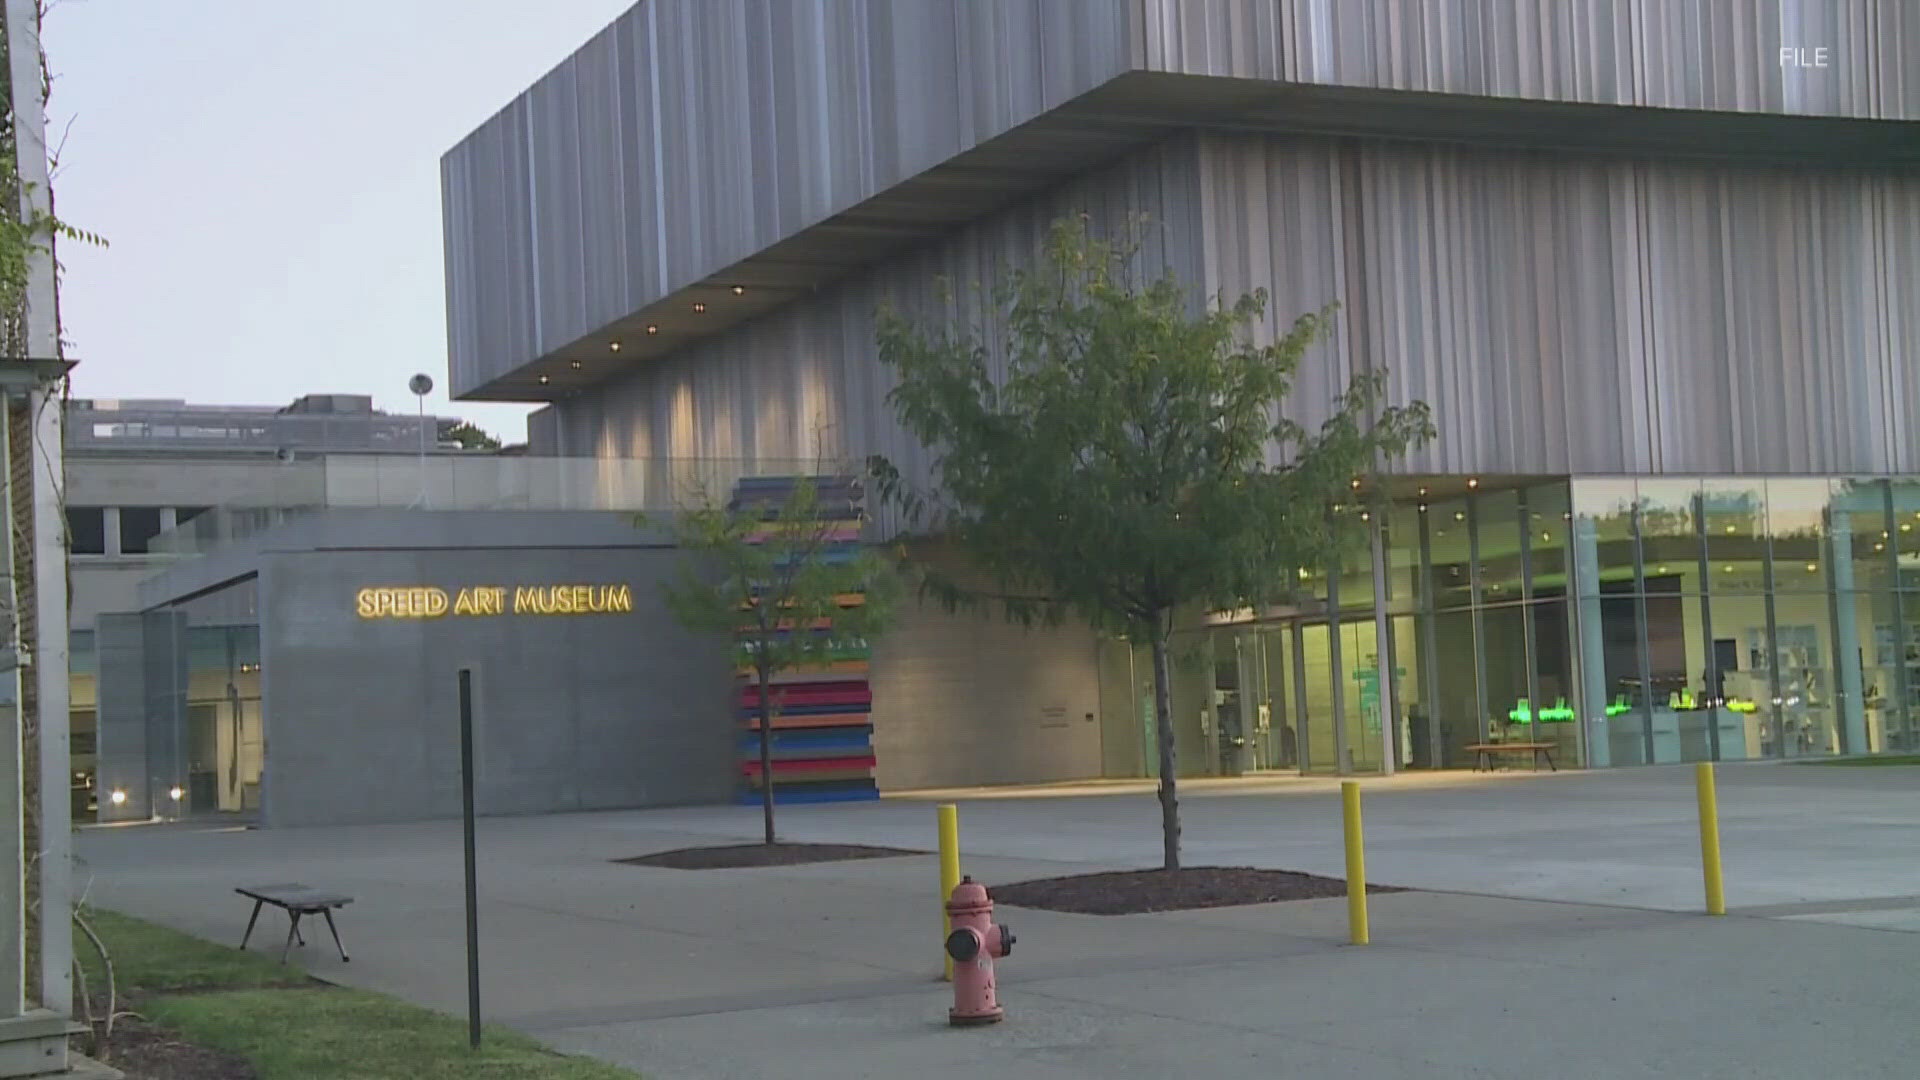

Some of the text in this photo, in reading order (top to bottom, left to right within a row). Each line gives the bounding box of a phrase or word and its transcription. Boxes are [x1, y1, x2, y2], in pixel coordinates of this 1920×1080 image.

[357, 584, 632, 618] SPEED ART MUSEUM
